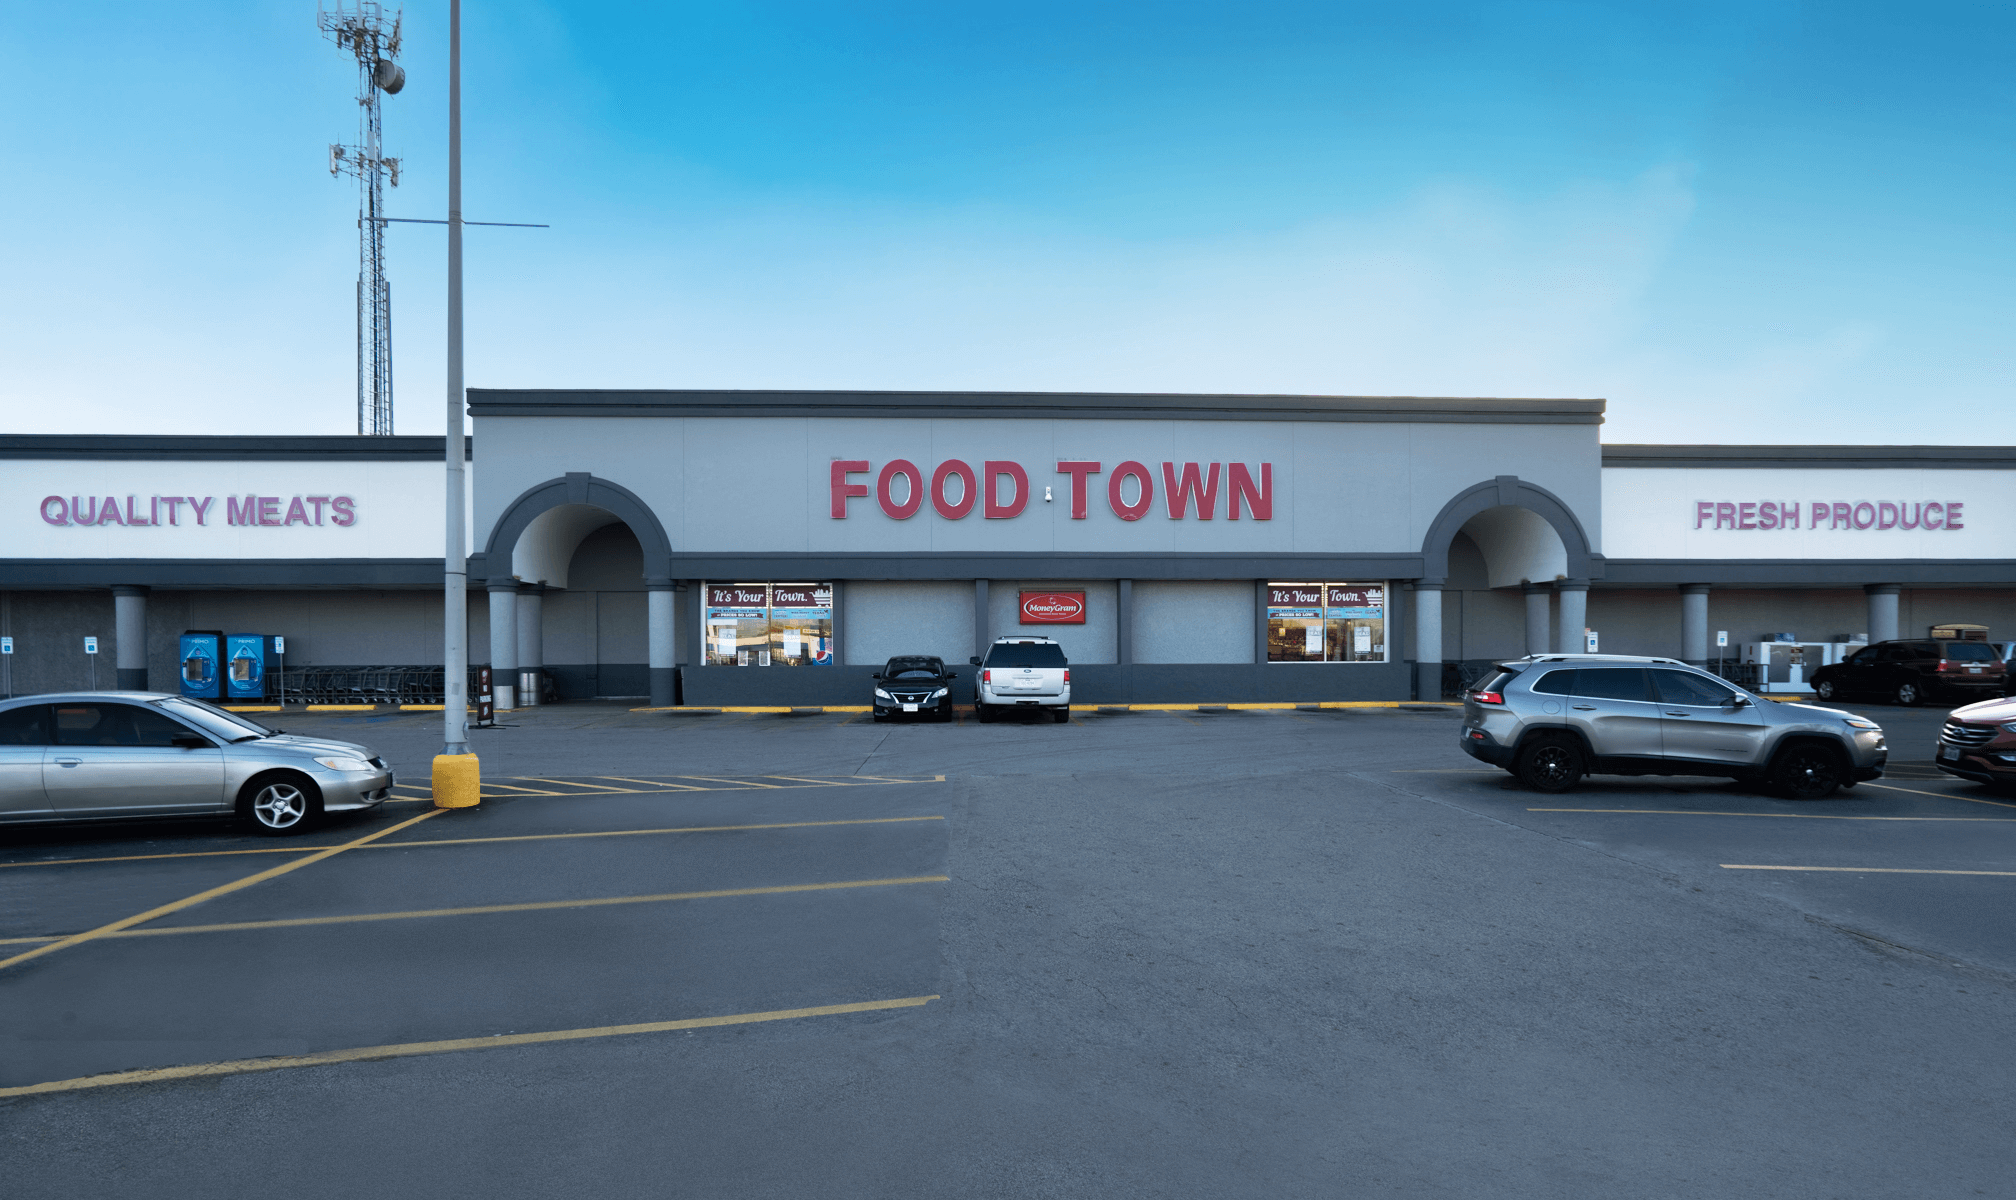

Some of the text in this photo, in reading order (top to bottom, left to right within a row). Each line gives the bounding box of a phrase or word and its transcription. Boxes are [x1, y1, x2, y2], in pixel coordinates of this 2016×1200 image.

[829, 458, 1273, 522] FOOD TOWN
[39, 495, 356, 527] QUALITY MEATS
[1695, 501, 1965, 530] FRESH PRODUCE
[713, 589, 808, 603] It's Your Town.
[1272, 589, 1361, 603] It's Your Town.
[1028, 604, 1077, 613] MoneyGram
